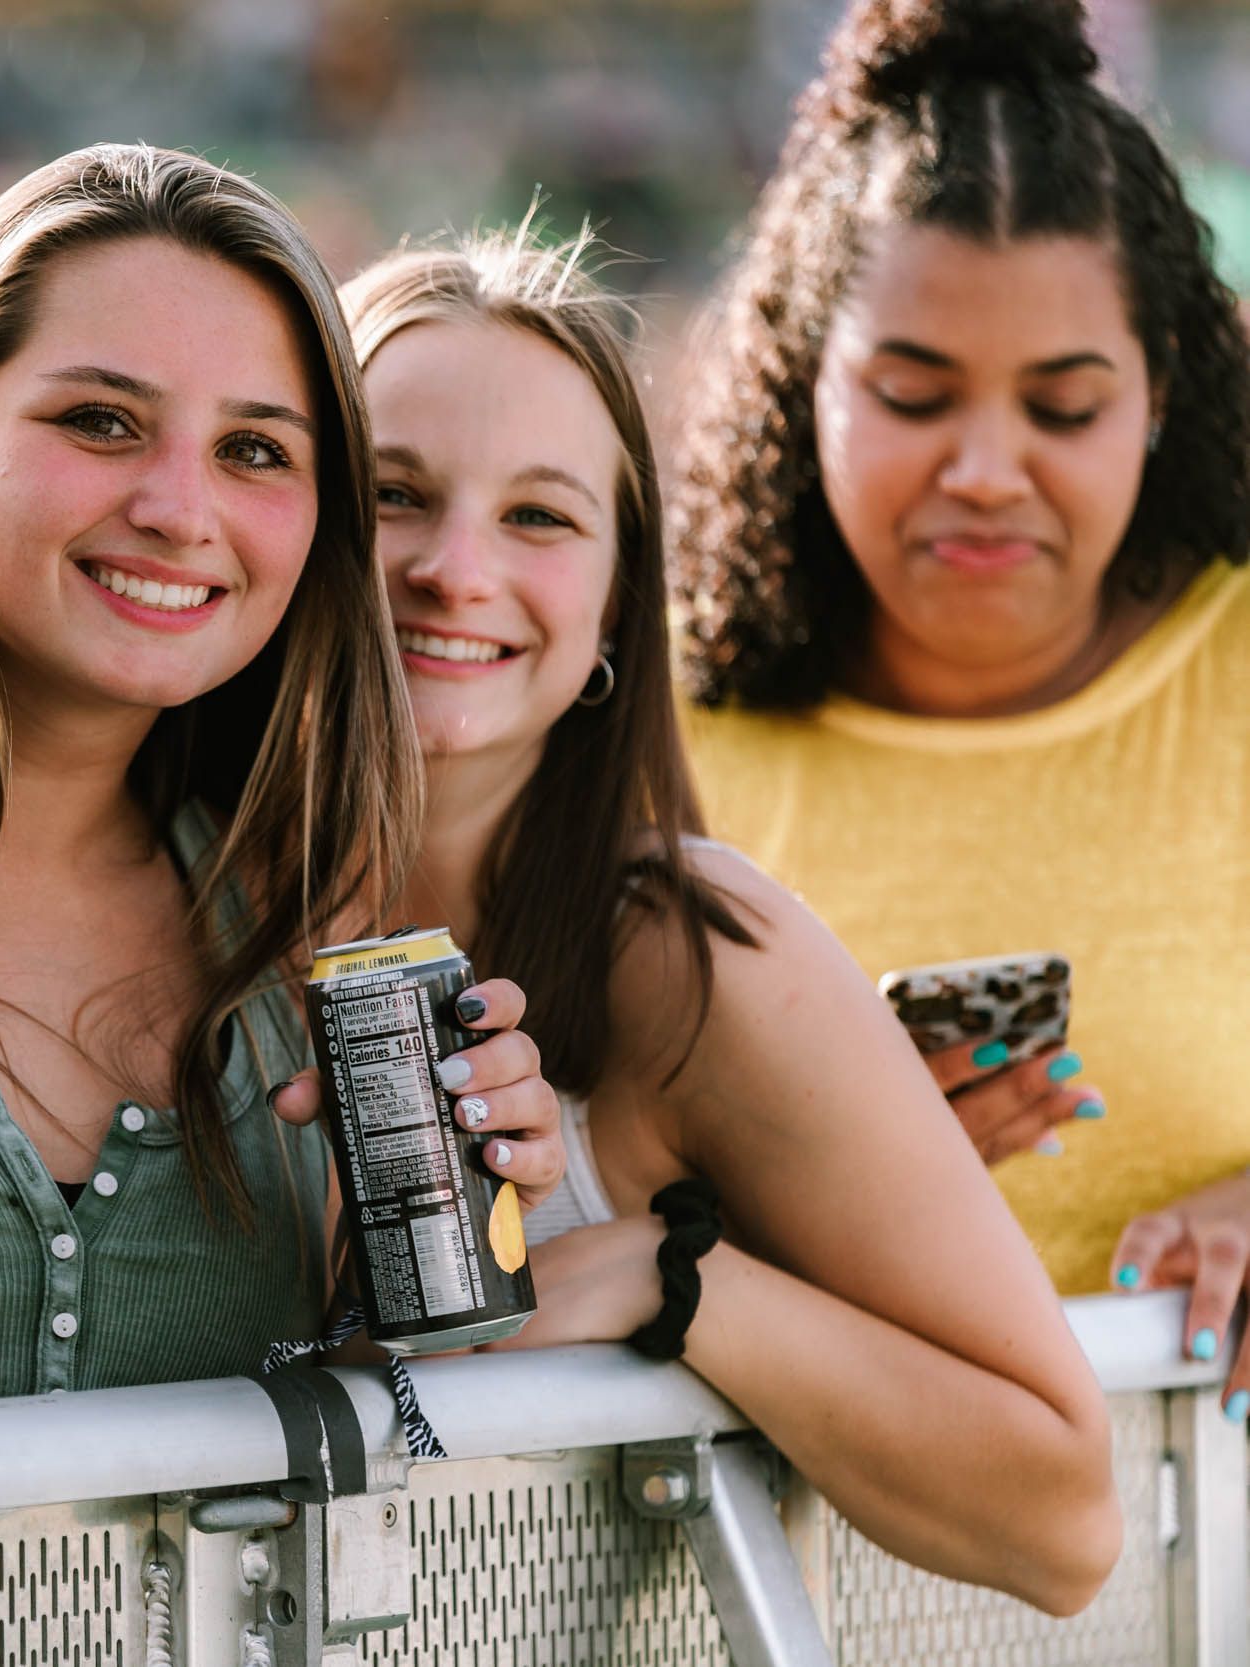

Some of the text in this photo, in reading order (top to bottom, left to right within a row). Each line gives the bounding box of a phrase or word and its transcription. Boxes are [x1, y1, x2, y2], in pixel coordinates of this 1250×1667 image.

[368, 952, 408, 968] LEMONADE
[371, 970, 403, 983] FLAVORED
[344, 987, 362, 998] OTHER
[362, 982, 391, 995] NATURAL
[417, 986, 429, 1001] FREE
[340, 993, 414, 1016] Nutrition Facts
[420, 1000, 433, 1023] GLUTEN
[345, 1015, 368, 1027] serving
[368, 1013, 380, 1023] per
[379, 1007, 408, 1020] contai
[374, 1024, 377, 1032] 1
[378, 1023, 389, 1031] can
[390, 1019, 404, 1029] (473
[348, 1035, 422, 1063] Calories 140
[353, 1076, 367, 1084] Total
[379, 1073, 387, 1081] 0g
[376, 1081, 393, 1091] 40mg
[356, 1094, 370, 1102] Total
[389, 1090, 397, 1099] 4g
[361, 1103, 374, 1111] Total
[375, 1099, 397, 1110] Sugars
[438, 1100, 449, 1112] CAN
[331, 1060, 366, 1202] BUDLIGHT.COM
[445, 1138, 457, 1151] PER
[456, 1197, 470, 1223] FLAVORS
[450, 1228, 463, 1258] 26186
[461, 1222, 475, 1249] NATURAL
[467, 1253, 481, 1279] ALCOHOL
[456, 1263, 469, 1291] 18200
